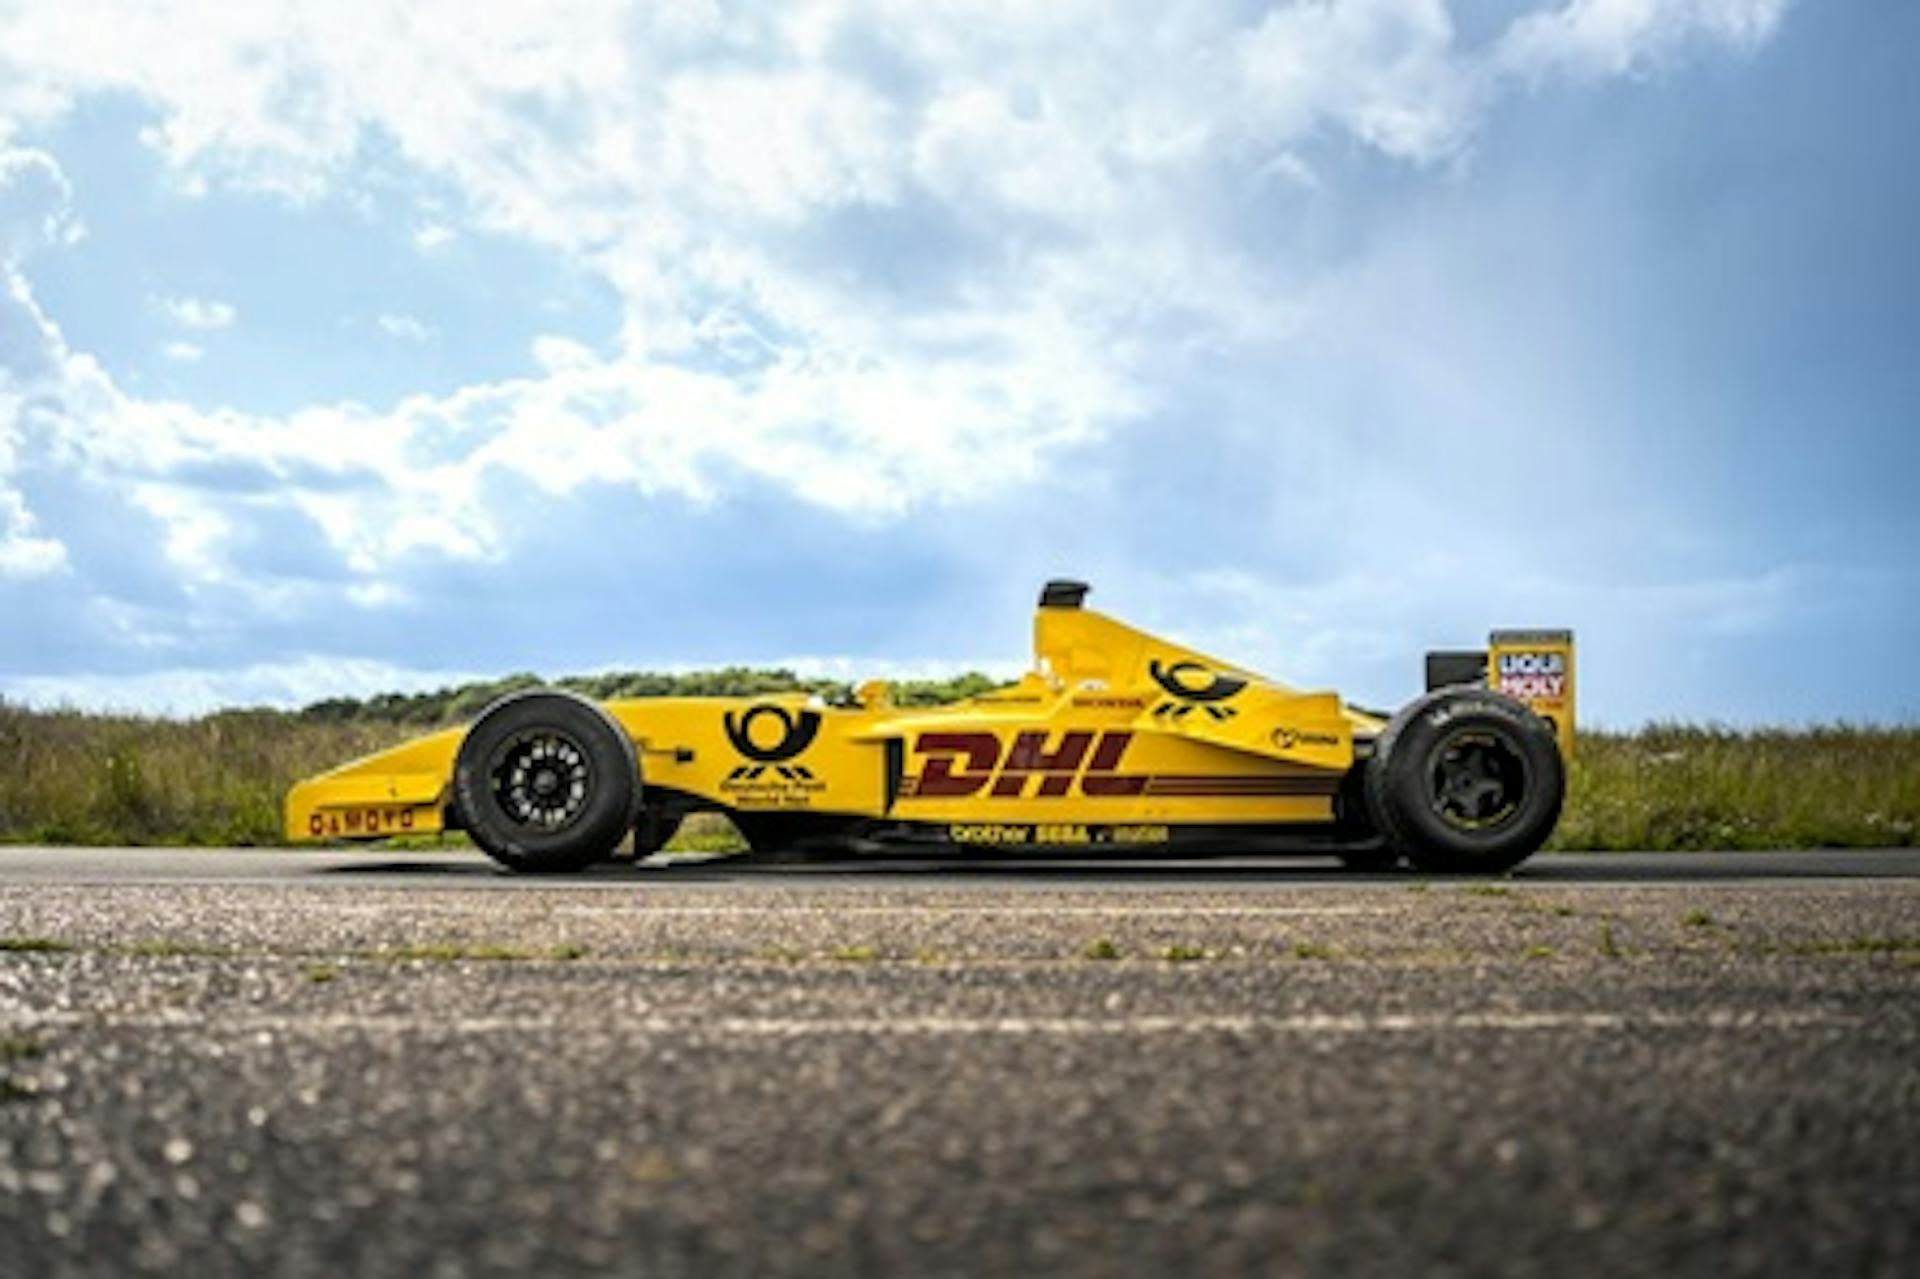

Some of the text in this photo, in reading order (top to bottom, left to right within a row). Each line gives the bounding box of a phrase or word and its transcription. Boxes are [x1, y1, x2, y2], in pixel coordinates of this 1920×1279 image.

[1498, 674, 1564, 699] MOLY
[914, 733, 1148, 796] DHL
[950, 823, 1029, 843] brother
